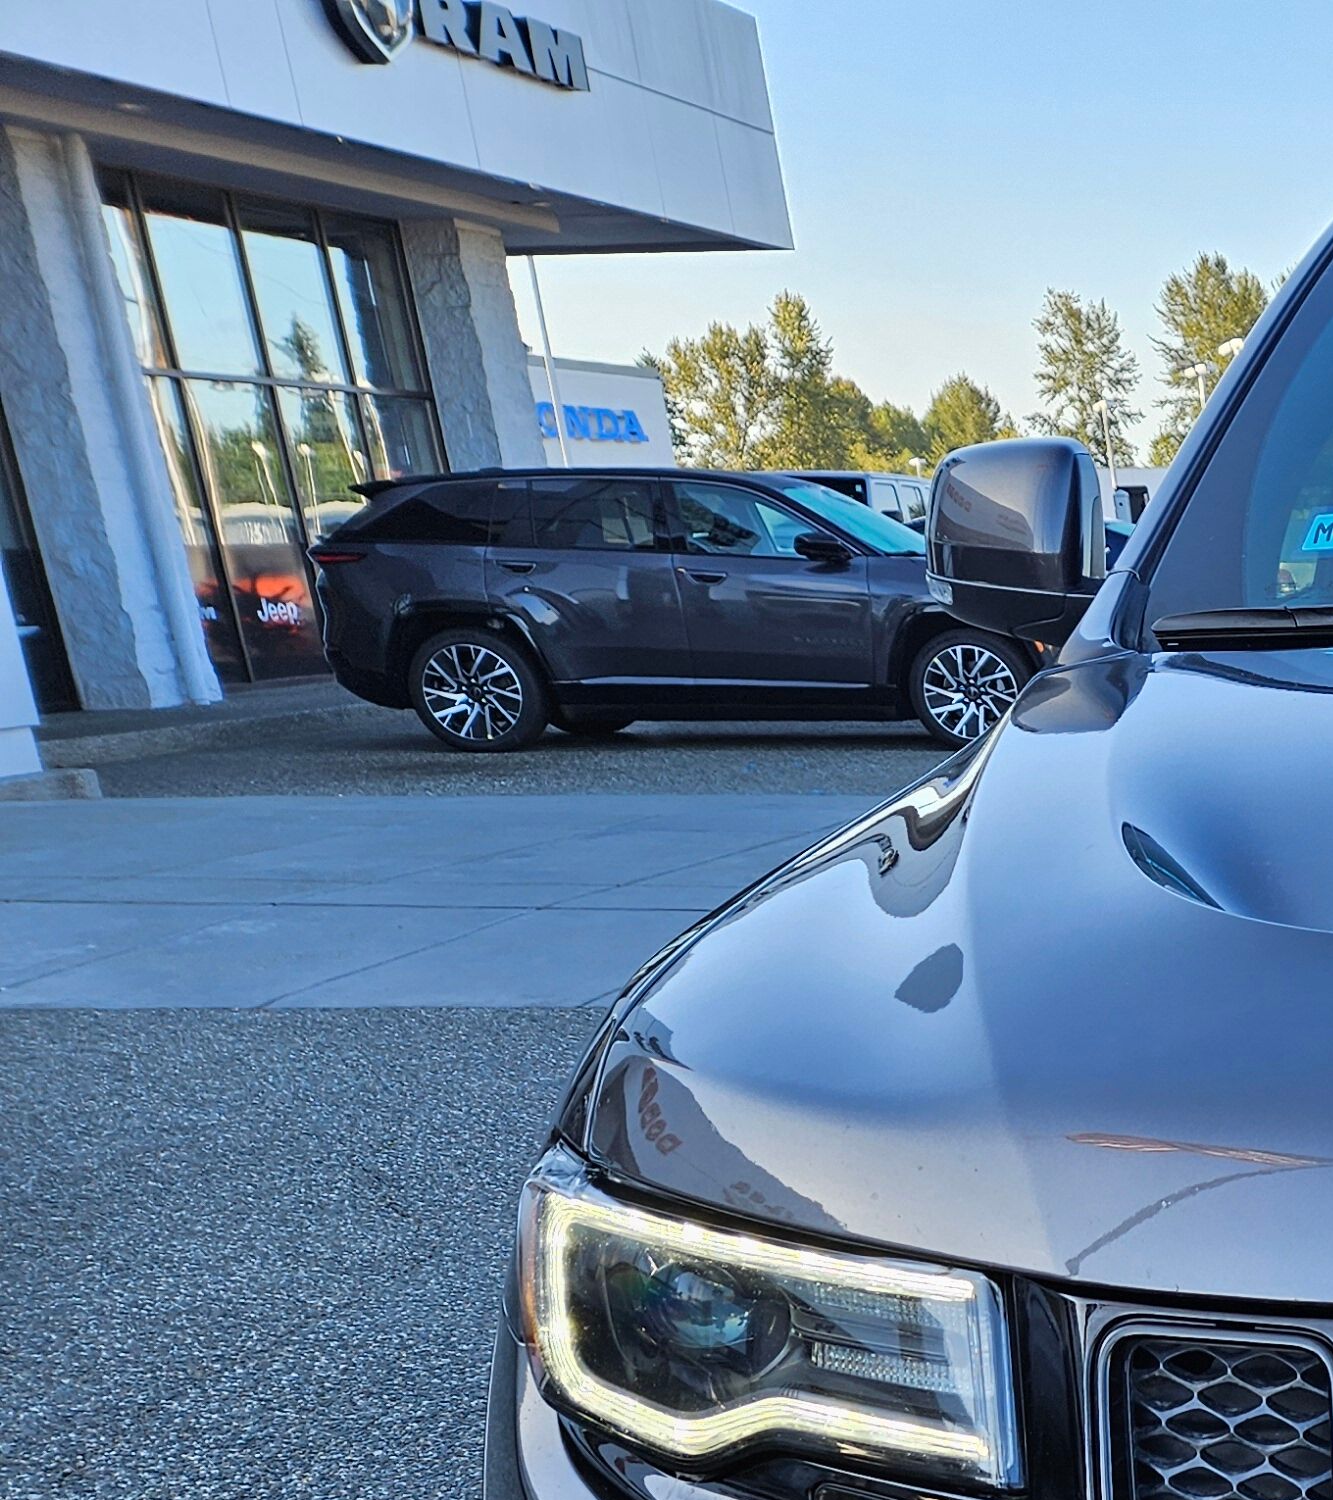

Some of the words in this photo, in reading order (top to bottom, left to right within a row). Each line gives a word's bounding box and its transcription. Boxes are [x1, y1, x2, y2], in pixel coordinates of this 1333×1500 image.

[418, 0, 590, 91] RAM
[535, 401, 649, 443] ONDA
[257, 597, 298, 625] Jeep
